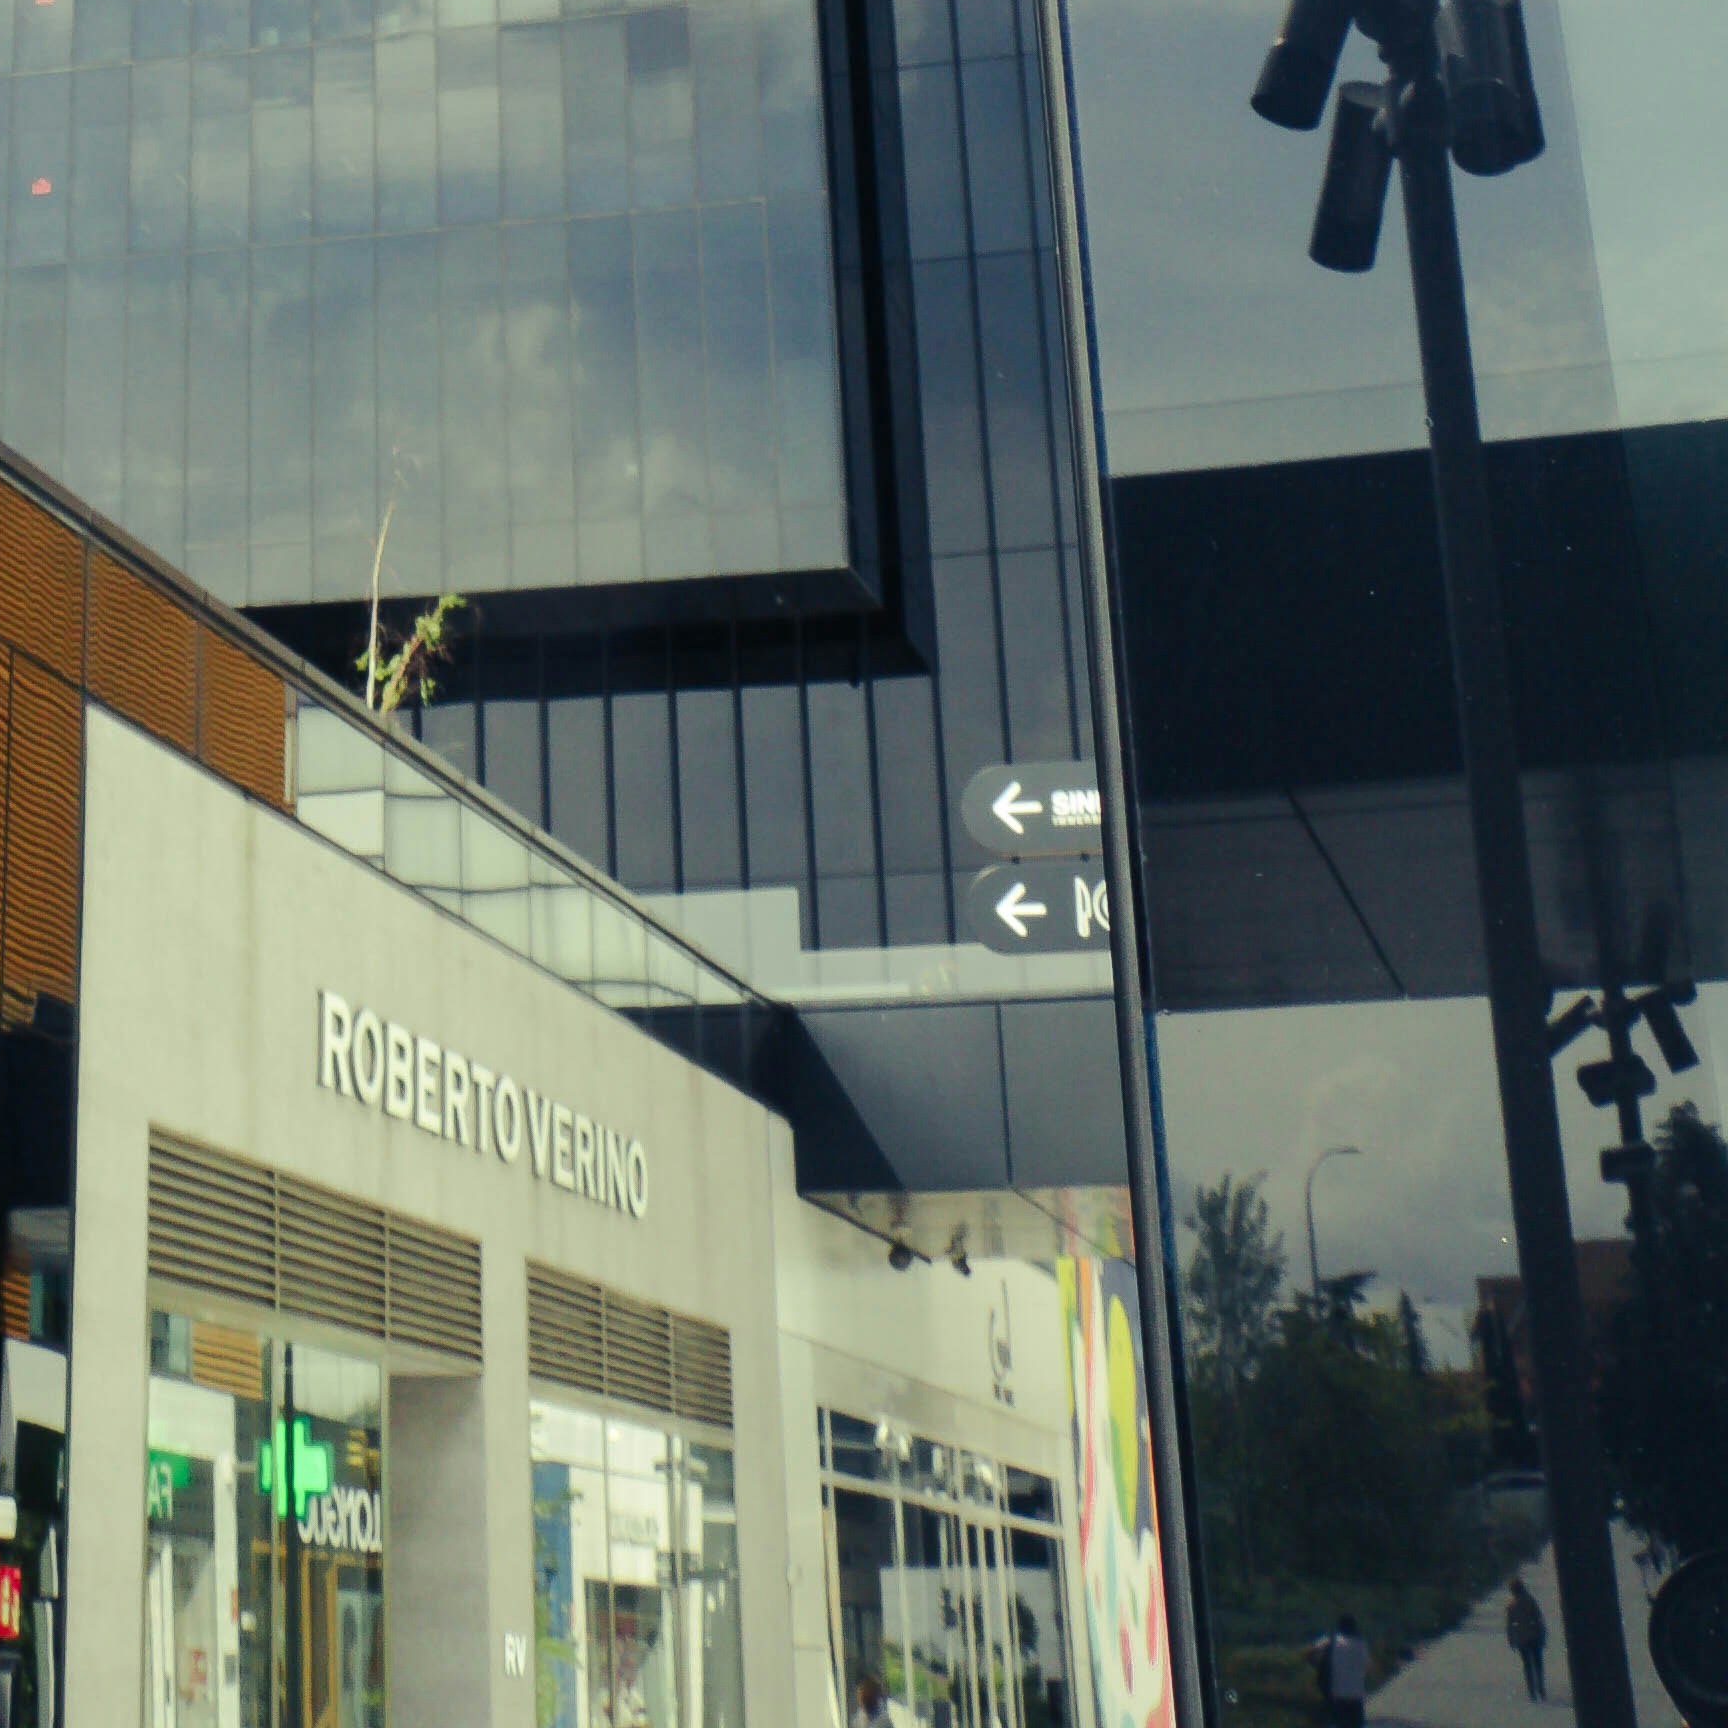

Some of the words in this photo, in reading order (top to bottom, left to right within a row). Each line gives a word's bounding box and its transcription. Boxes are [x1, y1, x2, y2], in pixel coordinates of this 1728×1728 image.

[318, 989, 523, 1163] ROBERTO
[523, 1087, 649, 1219] VERINO
[504, 1632, 526, 1677] RV
